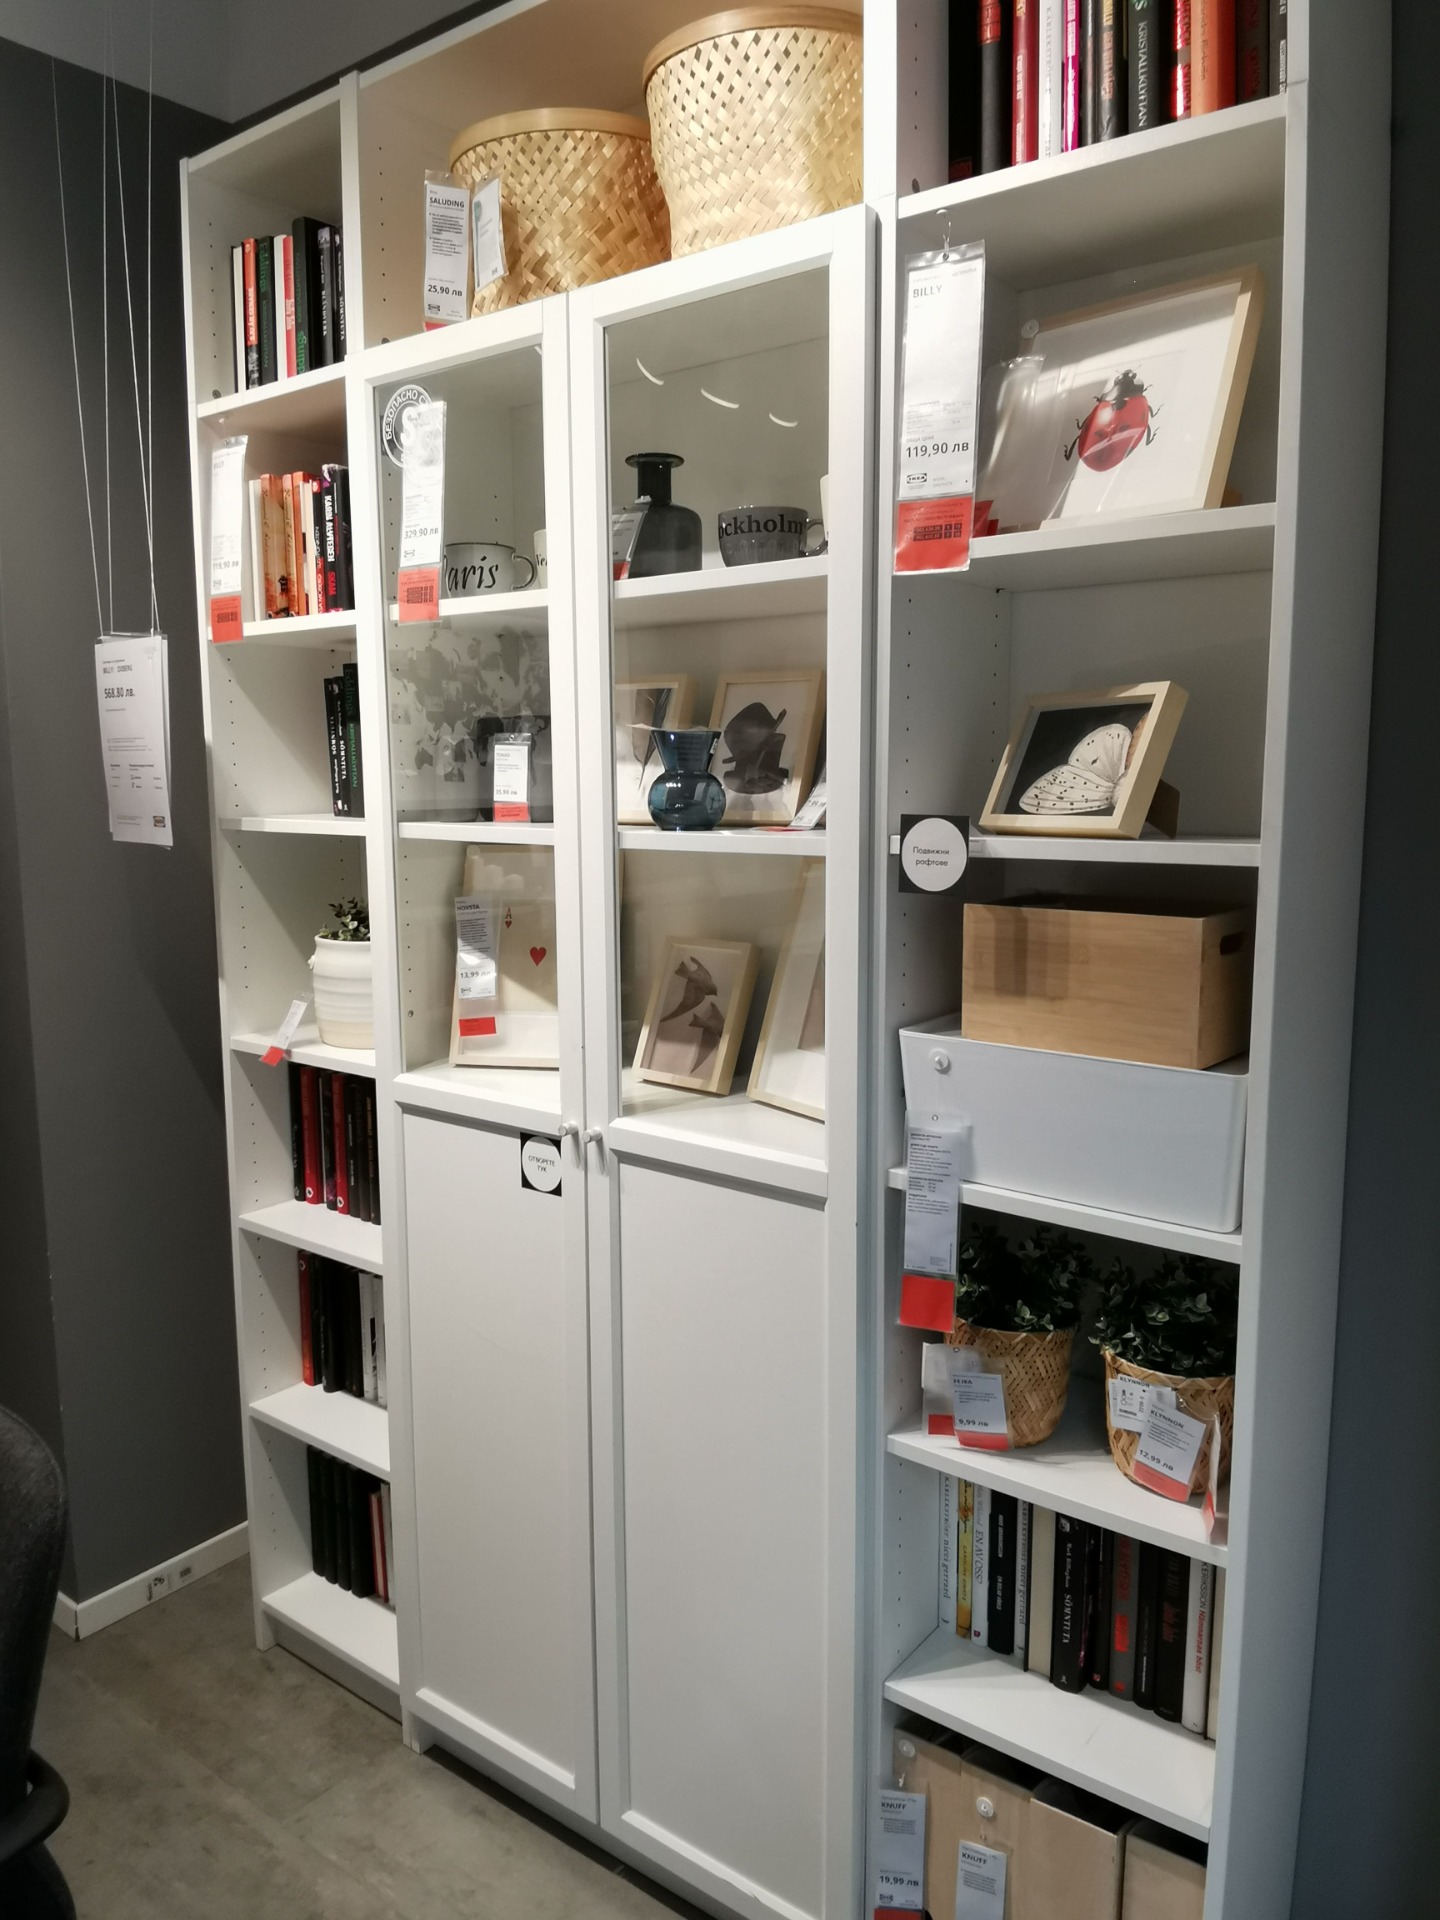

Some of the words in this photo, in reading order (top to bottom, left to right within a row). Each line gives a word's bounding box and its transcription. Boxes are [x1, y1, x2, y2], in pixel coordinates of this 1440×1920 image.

[1138, 21, 1148, 127] KRISTALLKLYFTAN
[913, 284, 942, 298] BILLY
[386, 390, 418, 440] БЕЗОПАСНО
[906, 442, 948, 458] 119,90
[952, 442, 969, 452] лв
[324, 495, 333, 520] KARIN
[913, 846, 950, 855] Подвижни
[916, 858, 948, 867] рафтове
[460, 971, 479, 979] 13,99
[528, 1155, 555, 1167] ОТВОРЕТЕ
[1120, 1376, 1150, 1388] KLYNNON
[1150, 1409, 1184, 1429] KLYNNON
[1139, 1449, 1161, 1464] 12,99
[975, 1529, 983, 1543] EN
[975, 1544, 983, 1560] AV
[974, 1559, 983, 1585] OSS?
[941, 1561, 950, 1599] gerrard
[1017, 1586, 1027, 1624] gerrard
[1062, 1594, 1073, 1644] SÖMNTUTA
[1196, 1609, 1206, 1654] Hämnarnas
[881, 1802, 906, 1810] KNUFF
[962, 1852, 987, 1864] KNUFF
[880, 1876, 904, 1885] 19,99
